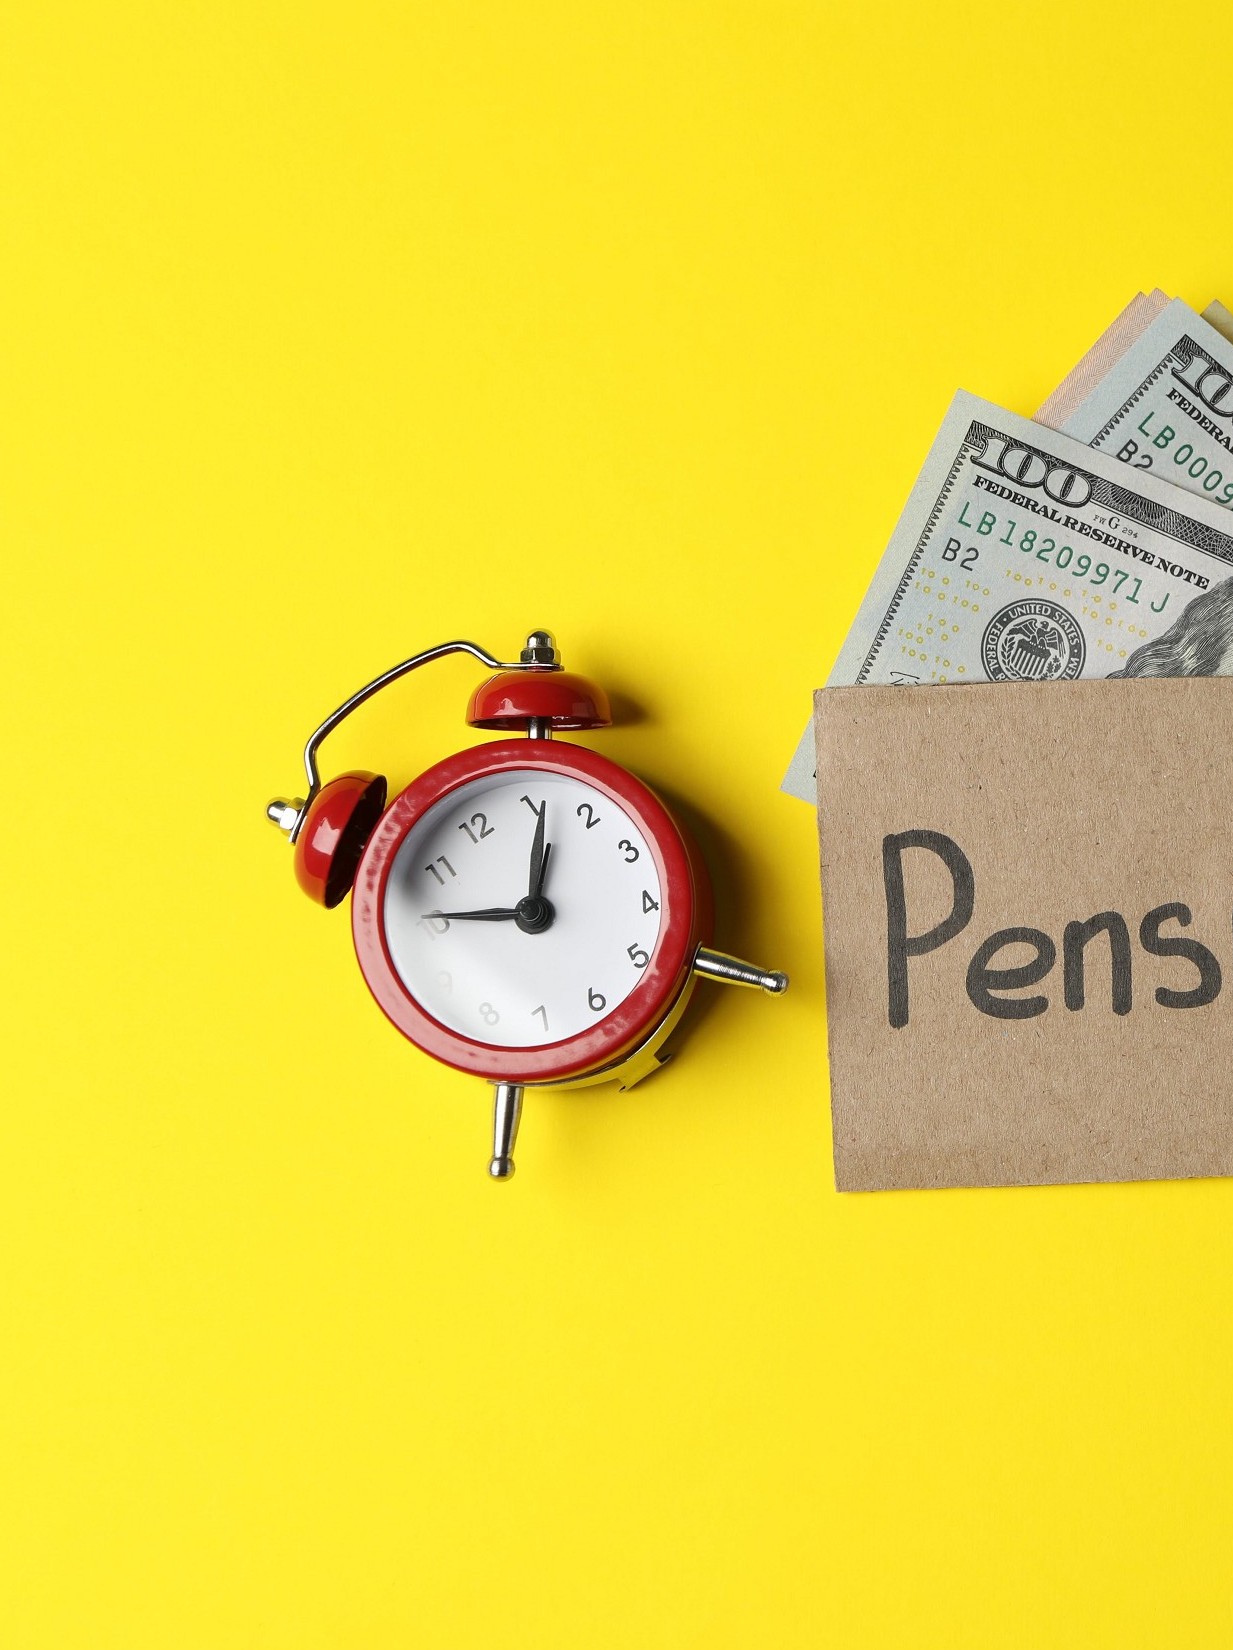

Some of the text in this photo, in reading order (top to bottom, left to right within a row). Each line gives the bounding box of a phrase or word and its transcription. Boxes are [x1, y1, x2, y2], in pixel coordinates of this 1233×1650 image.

[1116, 439, 1154, 470] B2
[970, 434, 1093, 508] 100
[972, 474, 1210, 590] FEDERAL RESERVE NOTE
[1108, 515, 1121, 531] G
[941, 537, 980, 572] B2
[1150, 592, 1171, 613] J
[1008, 604, 1080, 646] UNITED STATES
[986, 622, 1004, 671] FEDERAL
[1061, 657, 1080, 680] TEM
[458, 795, 601, 844] 12 1 2
[618, 839, 641, 863] 3
[424, 855, 457, 885] 11
[641, 889, 659, 914] 4
[626, 942, 650, 969] 5
[587, 987, 607, 1012] 6
[479, 1002, 500, 1026] 8
[530, 1004, 549, 1032] 7
